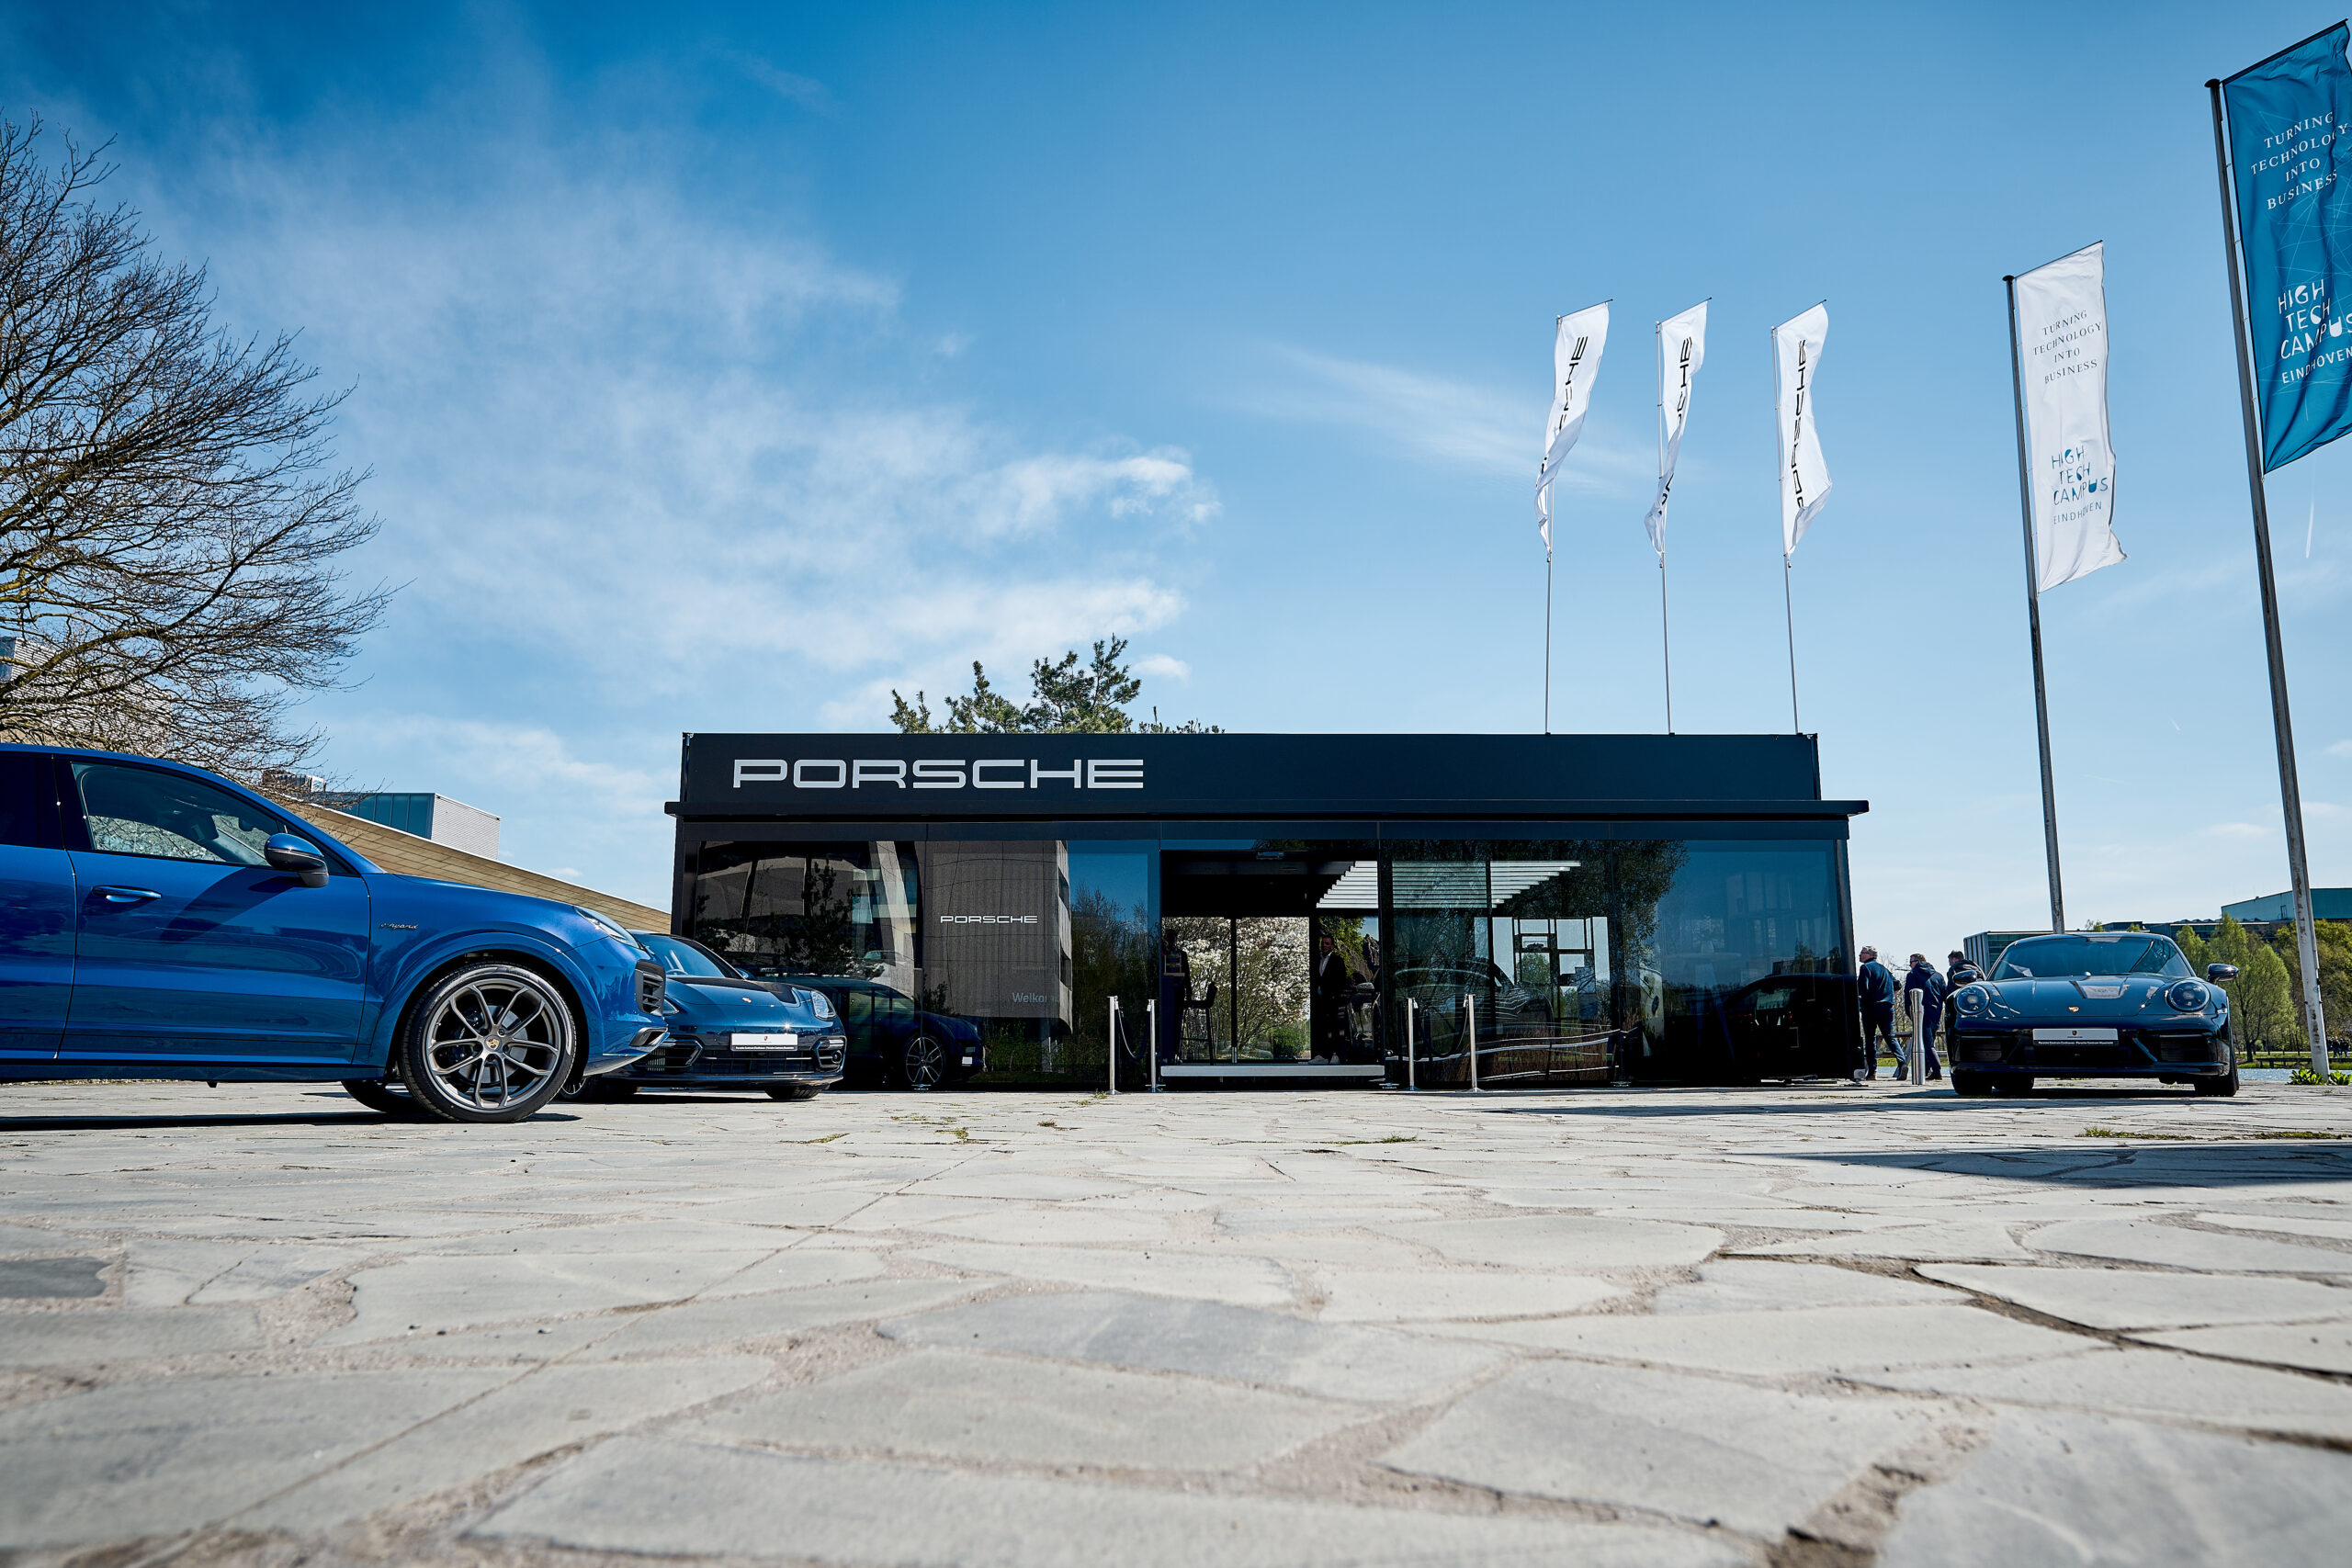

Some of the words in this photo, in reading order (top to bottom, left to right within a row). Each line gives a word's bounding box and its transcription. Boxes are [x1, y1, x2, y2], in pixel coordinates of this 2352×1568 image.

[2264, 111, 2334, 149] TURNING
[2250, 122, 2348, 175] TECHNOLOY
[2285, 157, 2320, 182] INTO
[2267, 169, 2337, 209] BUSINESS
[2278, 278, 2324, 314] HIGH
[2042, 310, 2087, 336] TURNING
[2285, 298, 2331, 333] TECH
[2033, 321, 2101, 355] TECHNOLOGY
[2054, 347, 2080, 364] INTO
[2044, 359, 2098, 385] BUSINESS
[2051, 445, 2084, 469] HIGH
[2059, 462, 2091, 485] TECH
[2053, 477, 2109, 506] CAMPUS
[2053, 501, 2102, 525] EINDHOVEN
[733, 759, 1144, 789] PORSCHE
[940, 915, 1038, 924] PORSCHE
[1012, 992, 1047, 1003] Welko
